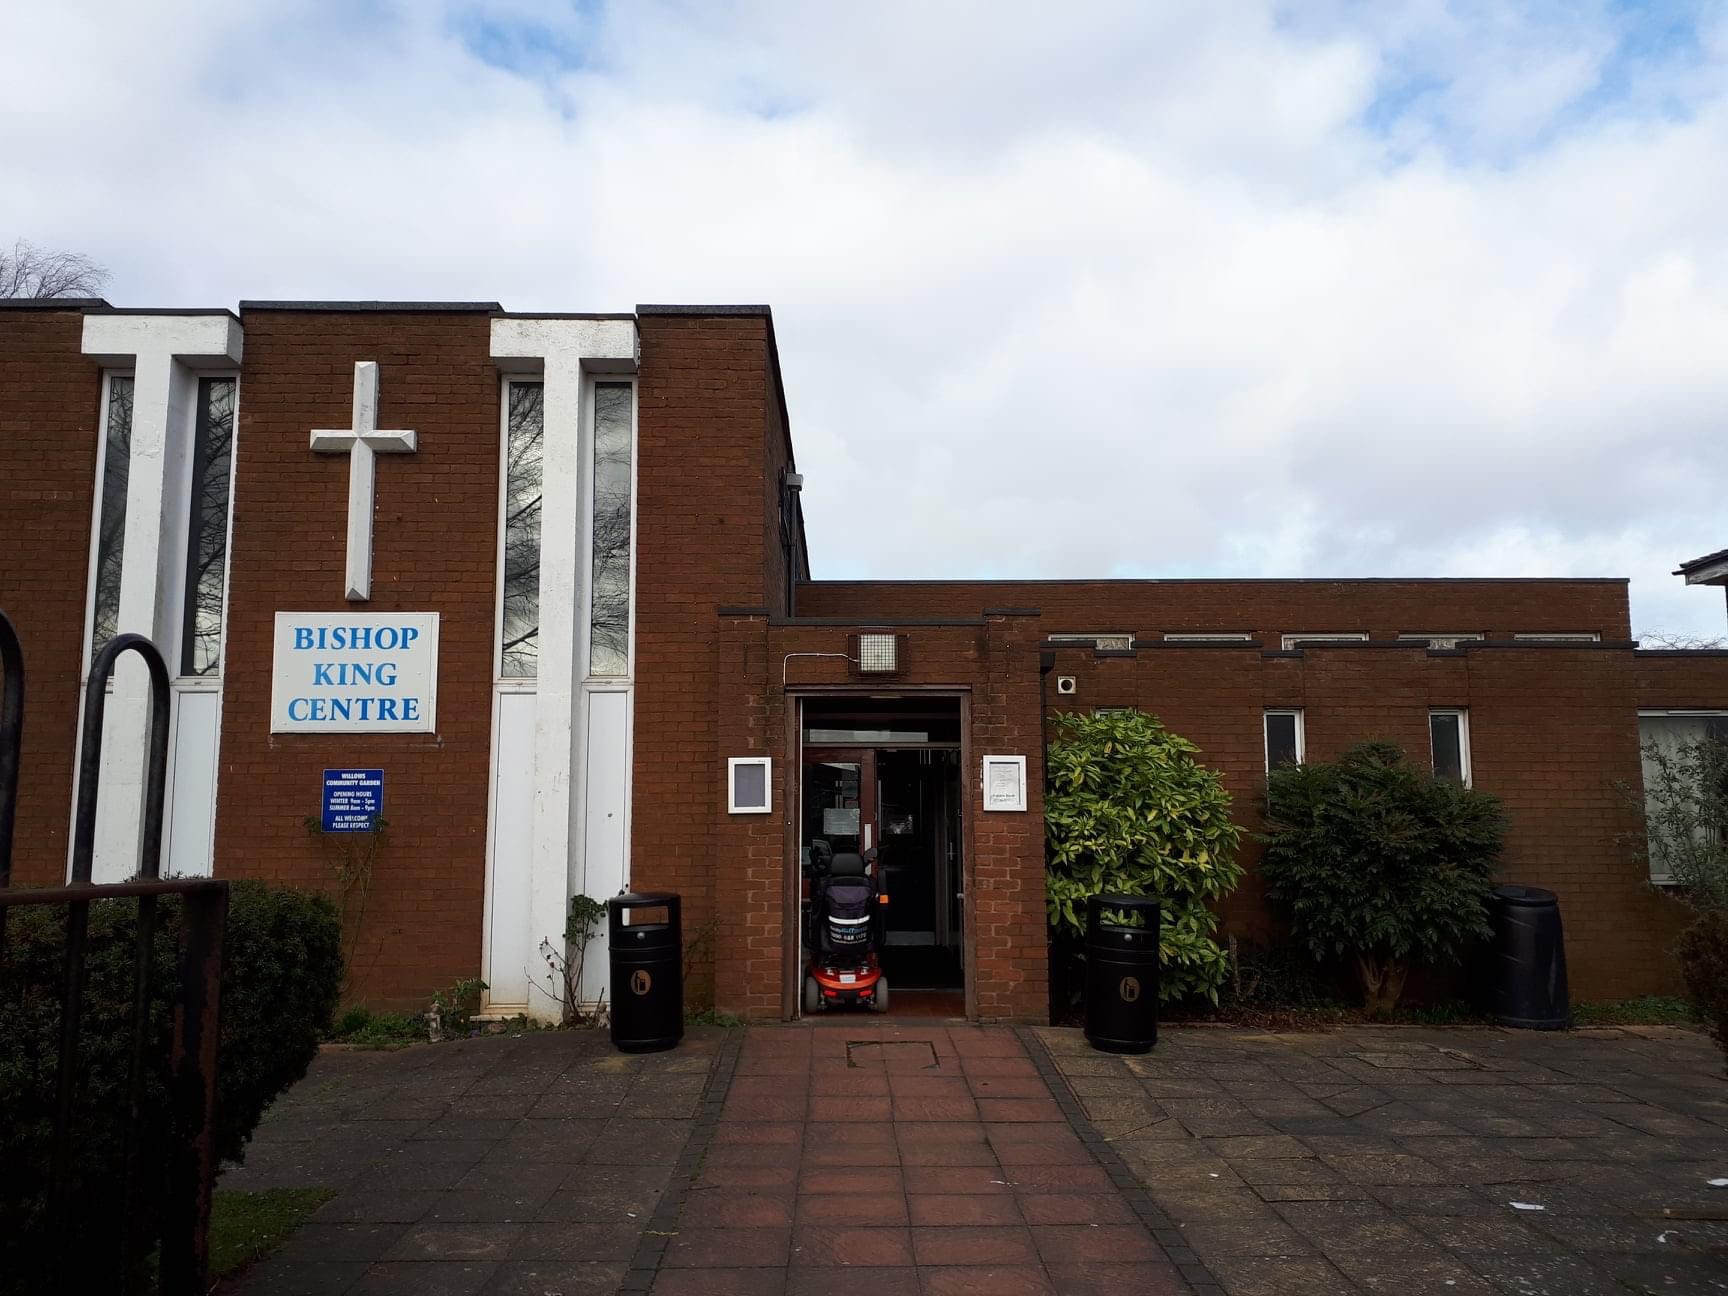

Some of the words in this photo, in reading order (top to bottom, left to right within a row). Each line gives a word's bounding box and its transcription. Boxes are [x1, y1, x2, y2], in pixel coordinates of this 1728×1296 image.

[293, 627, 419, 650] BISHOP
[312, 663, 397, 686] KING
[288, 697, 420, 721] CENTRE
